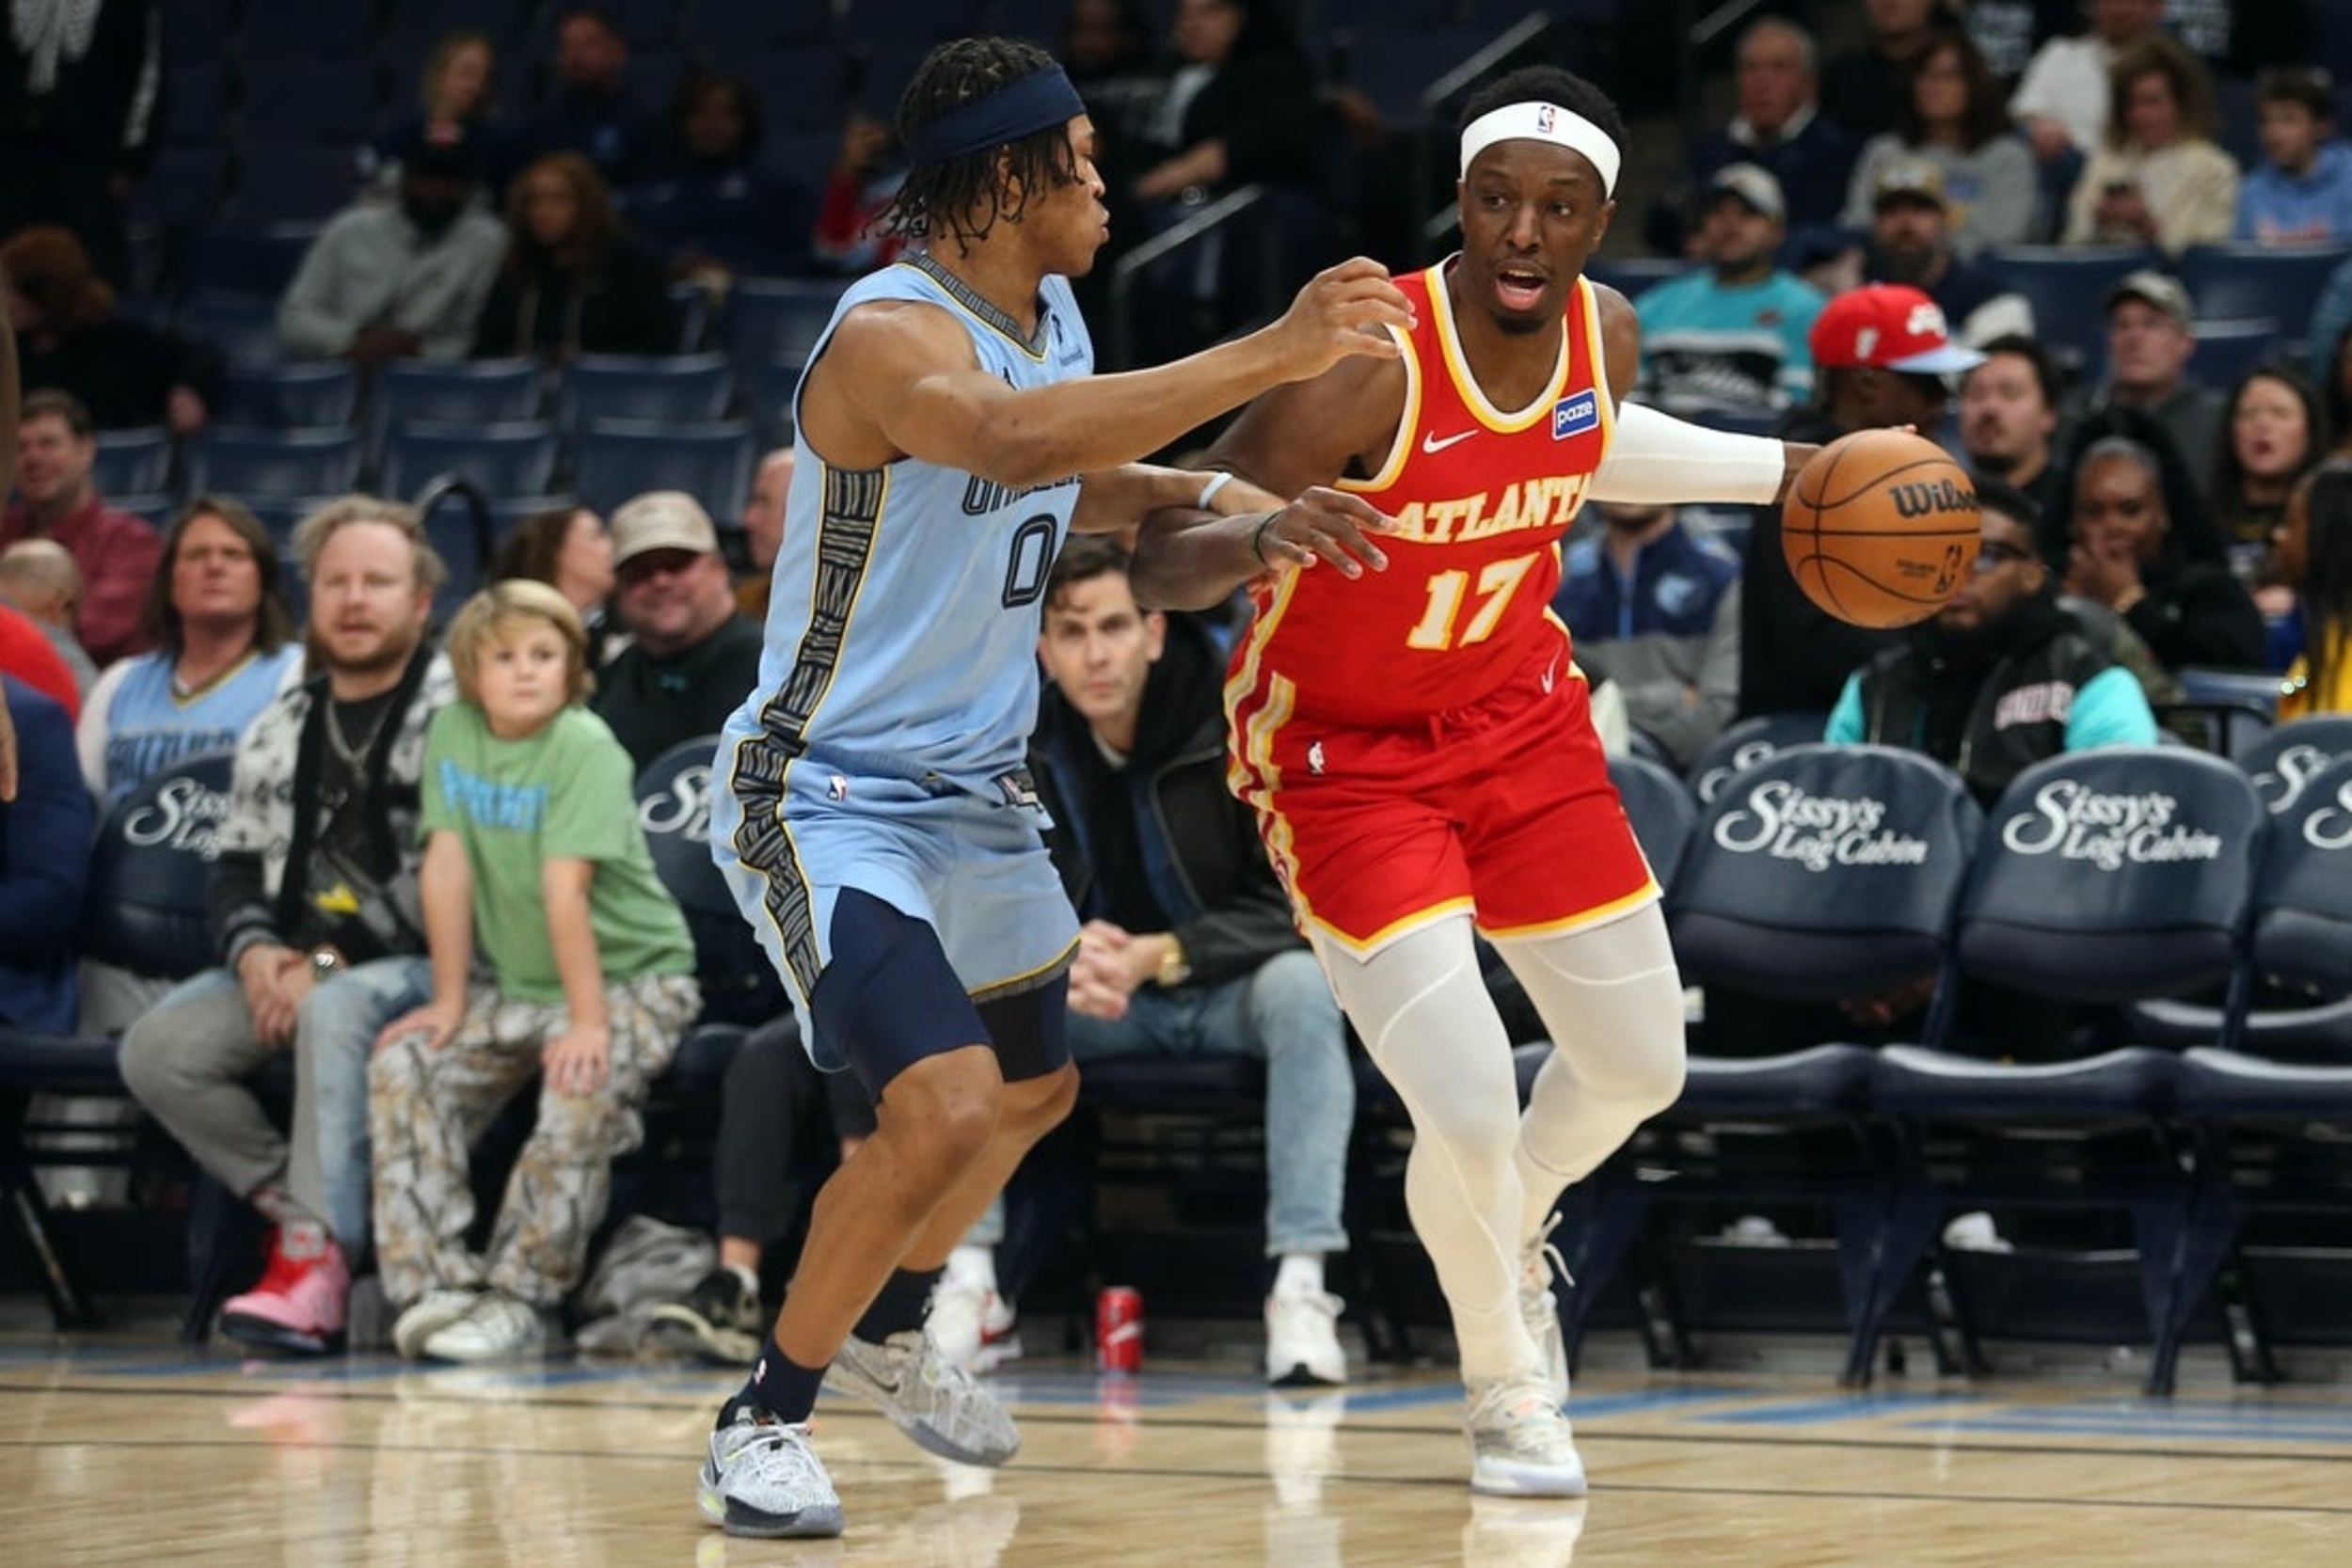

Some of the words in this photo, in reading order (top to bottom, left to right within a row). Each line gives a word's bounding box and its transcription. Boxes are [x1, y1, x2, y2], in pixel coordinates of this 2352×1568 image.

[1557, 401, 1594, 430] paze
[1888, 479, 1979, 518] Wilso
[1001, 513, 1058, 610] 0
[1406, 550, 1542, 651] 17
[123, 776, 233, 846] Siss
[1713, 780, 1885, 852] Sissy's
[2002, 779, 2177, 854] Sissy's
[1770, 824, 1836, 872] Log
[1836, 828, 1928, 864] Cabin
[2059, 822, 2126, 871] Log
[2127, 825, 2221, 863] Cabin
